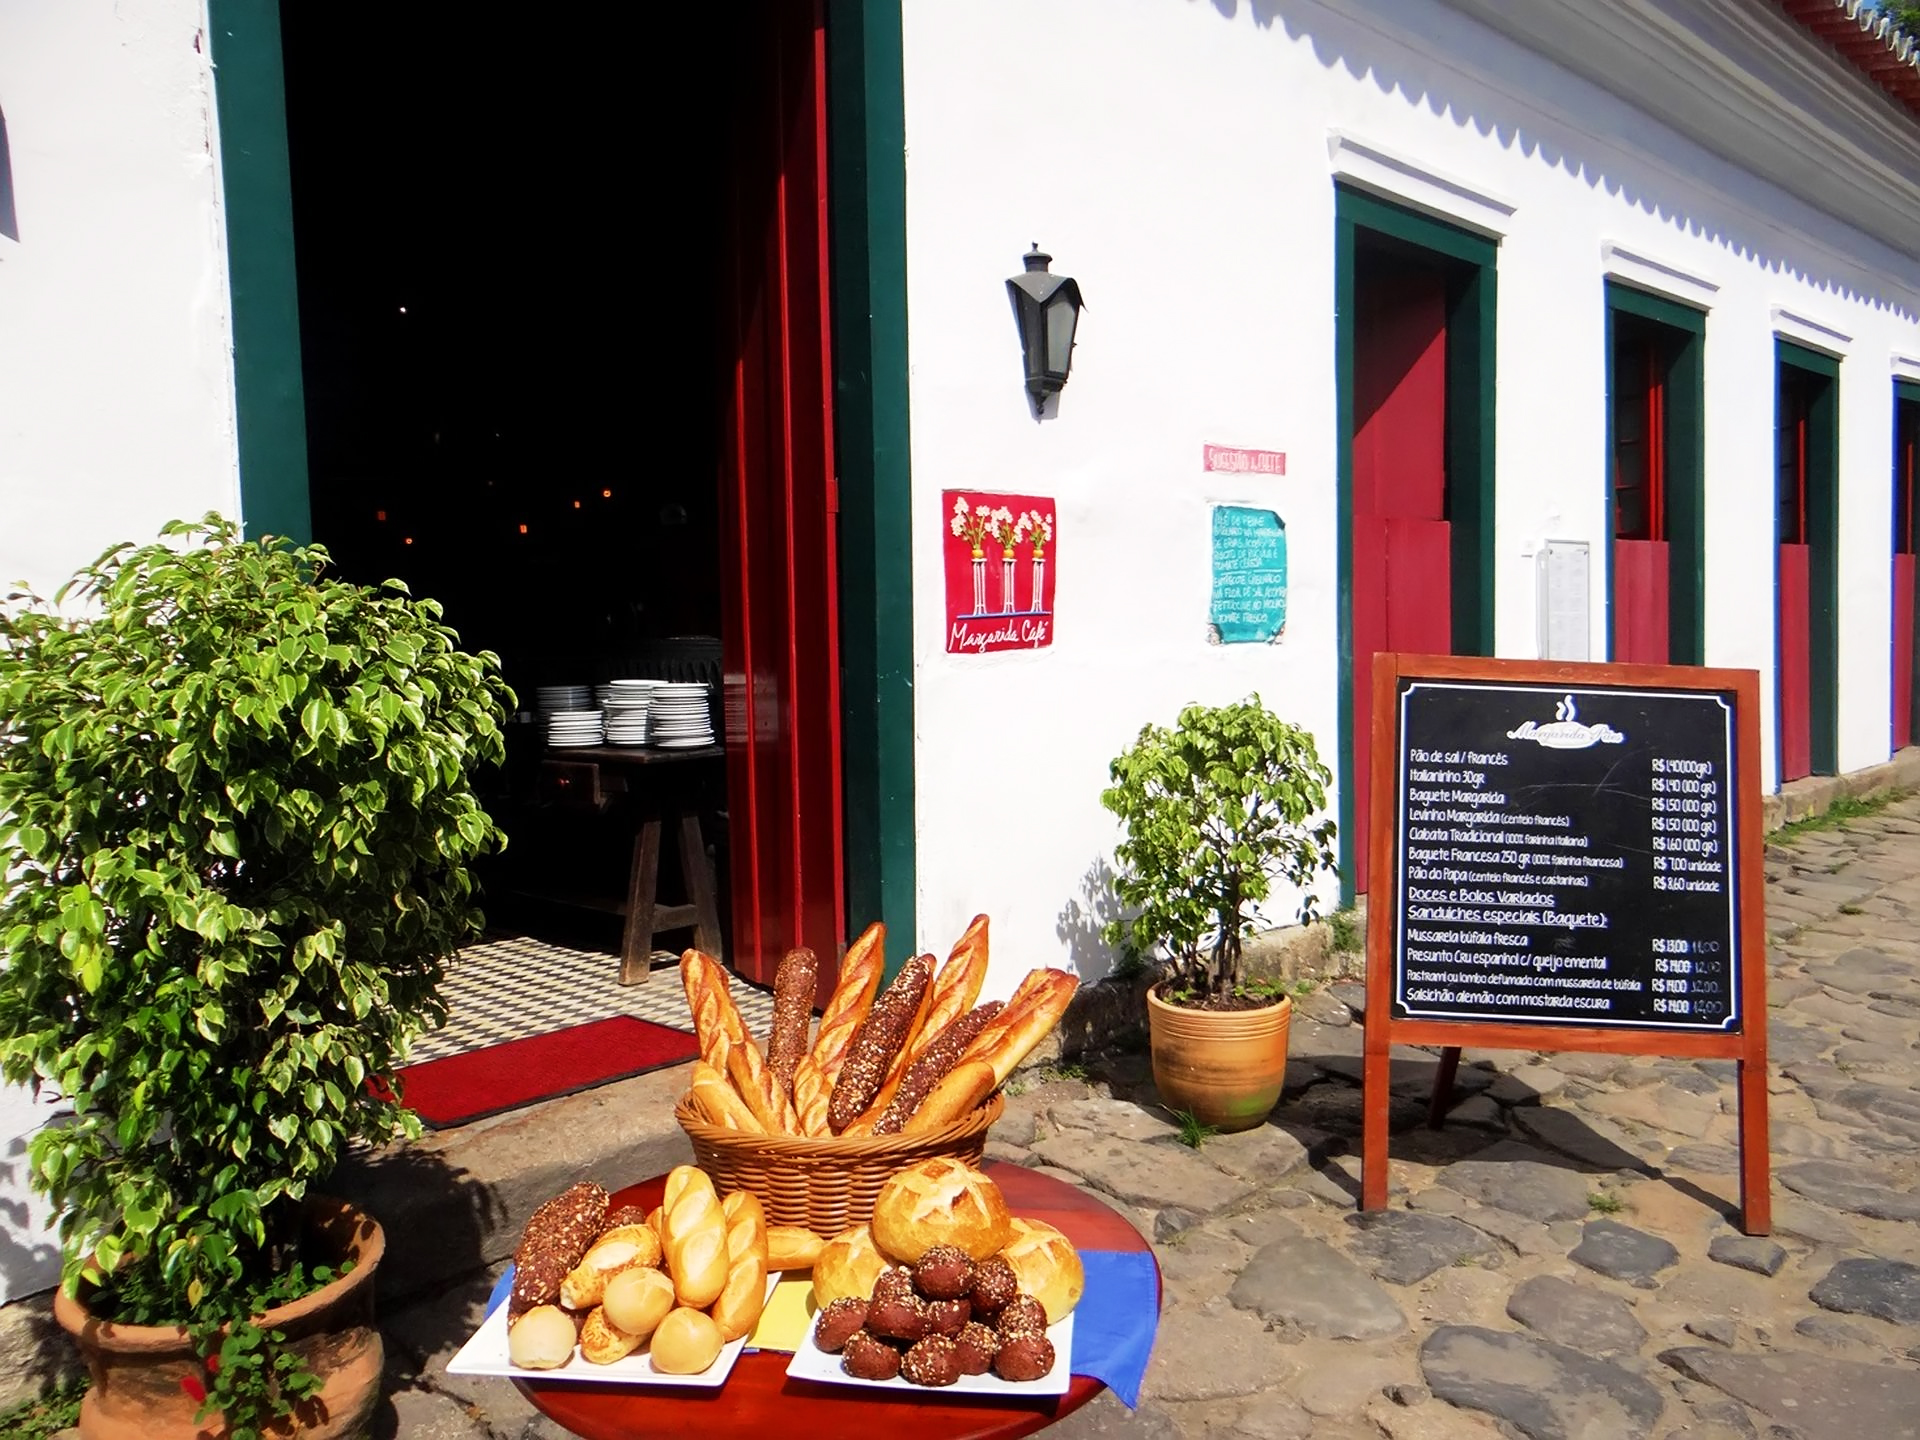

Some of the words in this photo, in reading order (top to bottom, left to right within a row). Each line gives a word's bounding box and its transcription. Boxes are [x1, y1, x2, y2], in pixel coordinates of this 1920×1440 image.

[948, 619, 1019, 654] Margarida
[1022, 620, 1049, 649] Café
[1410, 748, 1429, 762] Pão
[1430, 750, 1443, 763] de
[1444, 751, 1460, 764] sal
[1467, 751, 1508, 766] francês
[1652, 758, 1665, 772] R$
[1410, 768, 1460, 783] Italianinho
[1652, 778, 1665, 792] R$
[1409, 788, 1450, 806] Baguete
[1452, 789, 1505, 808] Margarida
[1652, 798, 1665, 812] R$
[1409, 808, 1446, 822] Levinho
[1447, 809, 1500, 828] Margarida
[1501, 813, 1534, 825] (centeio
[1652, 817, 1665, 832] R$
[1408, 826, 1448, 842] Ciabata
[1450, 828, 1504, 844] Tradicional
[1524, 834, 1555, 846] farinha
[1652, 836, 1666, 851] R$
[1408, 846, 1450, 865] Baguete
[1451, 848, 1500, 862] Francesa
[1501, 850, 1517, 864] 250
[1552, 855, 1582, 867] farinha
[1654, 856, 1668, 872] R$
[1688, 860, 1722, 872] unidade
[1408, 866, 1427, 880] Pão
[1428, 867, 1442, 881] do
[1443, 868, 1468, 884] Papa
[1468, 870, 1502, 883] (centeio
[1502, 872, 1535, 885] francês
[1535, 875, 1540, 884] e
[1653, 876, 1667, 891] R$
[1686, 880, 1720, 892] unidade
[1408, 886, 1448, 900] Doces
[1449, 890, 1457, 901] e
[1460, 888, 1495, 903] Bolos
[1496, 890, 1555, 906] Variados
[1483, 908, 1540, 926] especiais
[1407, 928, 1458, 944] Mussarela
[1460, 931, 1492, 945] búfala
[1493, 932, 1528, 946] fresca
[1652, 938, 1666, 953] R$
[1407, 948, 1453, 963] Presunto
[1454, 950, 1472, 964] Cru
[1472, 951, 1519, 968] espanhol
[1520, 953, 1531, 966] c/
[1532, 954, 1564, 972] queijo
[1564, 956, 1607, 970] emental
[1655, 958, 1668, 973] R$
[1407, 968, 1446, 982] Pastrami
[1447, 973, 1458, 983] ou
[1460, 972, 1487, 984] lombo
[1488, 974, 1532, 986] defumado
[1533, 976, 1554, 988] com
[1555, 978, 1600, 990] mussarela
[1601, 978, 1613, 990] de
[1614, 979, 1642, 992] búfala
[1652, 978, 1665, 993] R$
[1407, 987, 1455, 1002] Salsichão
[1456, 990, 1495, 1004] alemão
[1496, 993, 1520, 1005] com
[1520, 993, 1573, 1008] mostarda
[1574, 998, 1610, 1010] escura
[1654, 998, 1667, 1013] R$
